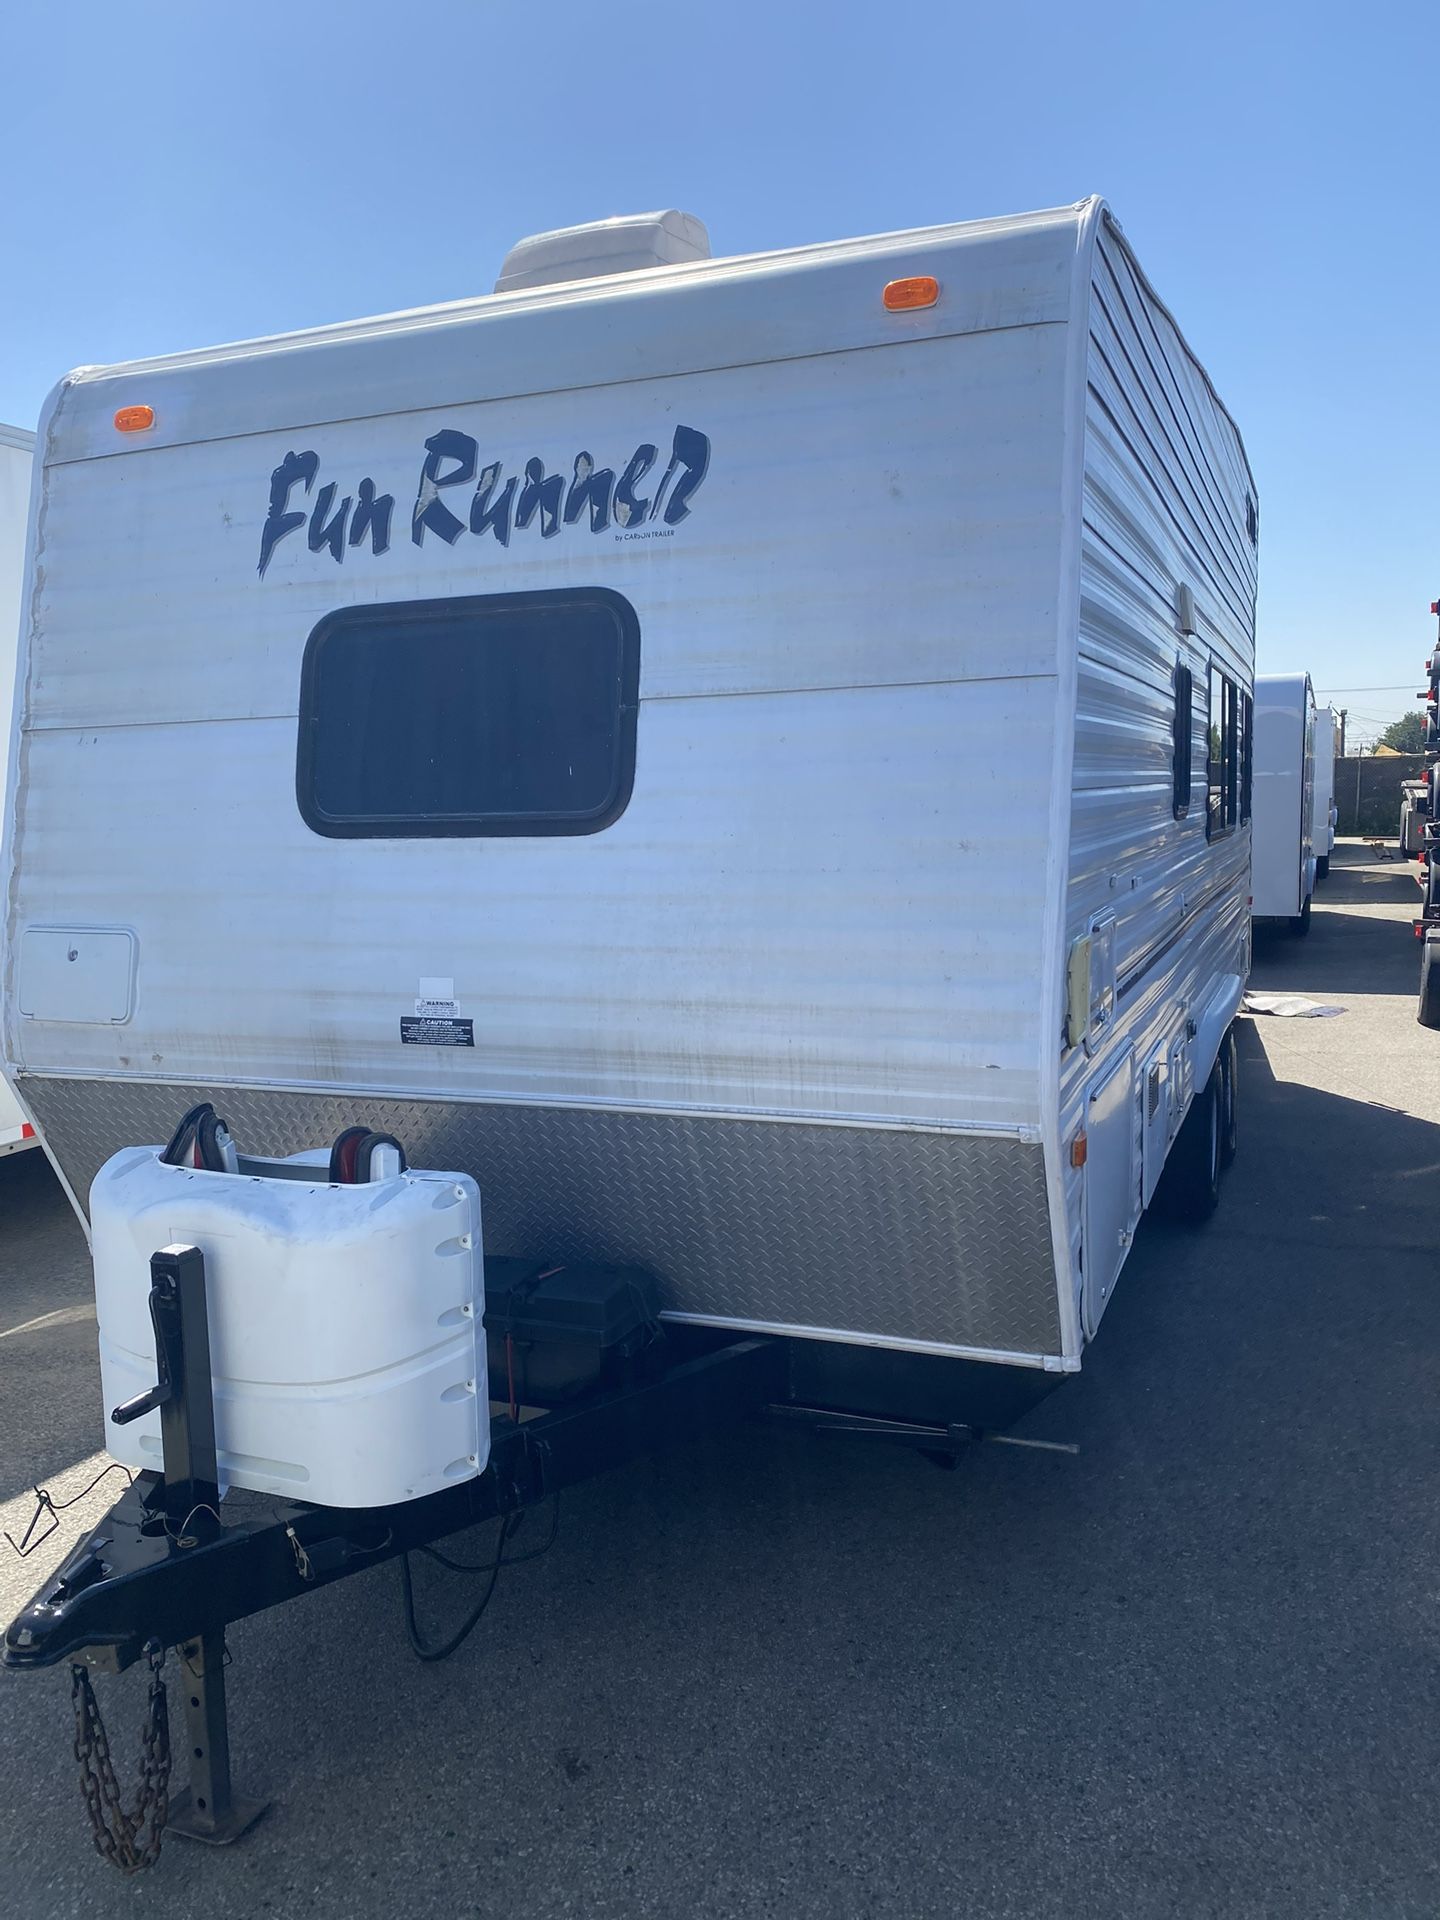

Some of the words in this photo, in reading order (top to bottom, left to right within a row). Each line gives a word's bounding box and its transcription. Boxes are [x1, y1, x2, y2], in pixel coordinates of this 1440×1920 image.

[257, 450, 396, 581] Fun
[411, 425, 711, 547] Runner
[651, 530, 675, 538] TRAILER
